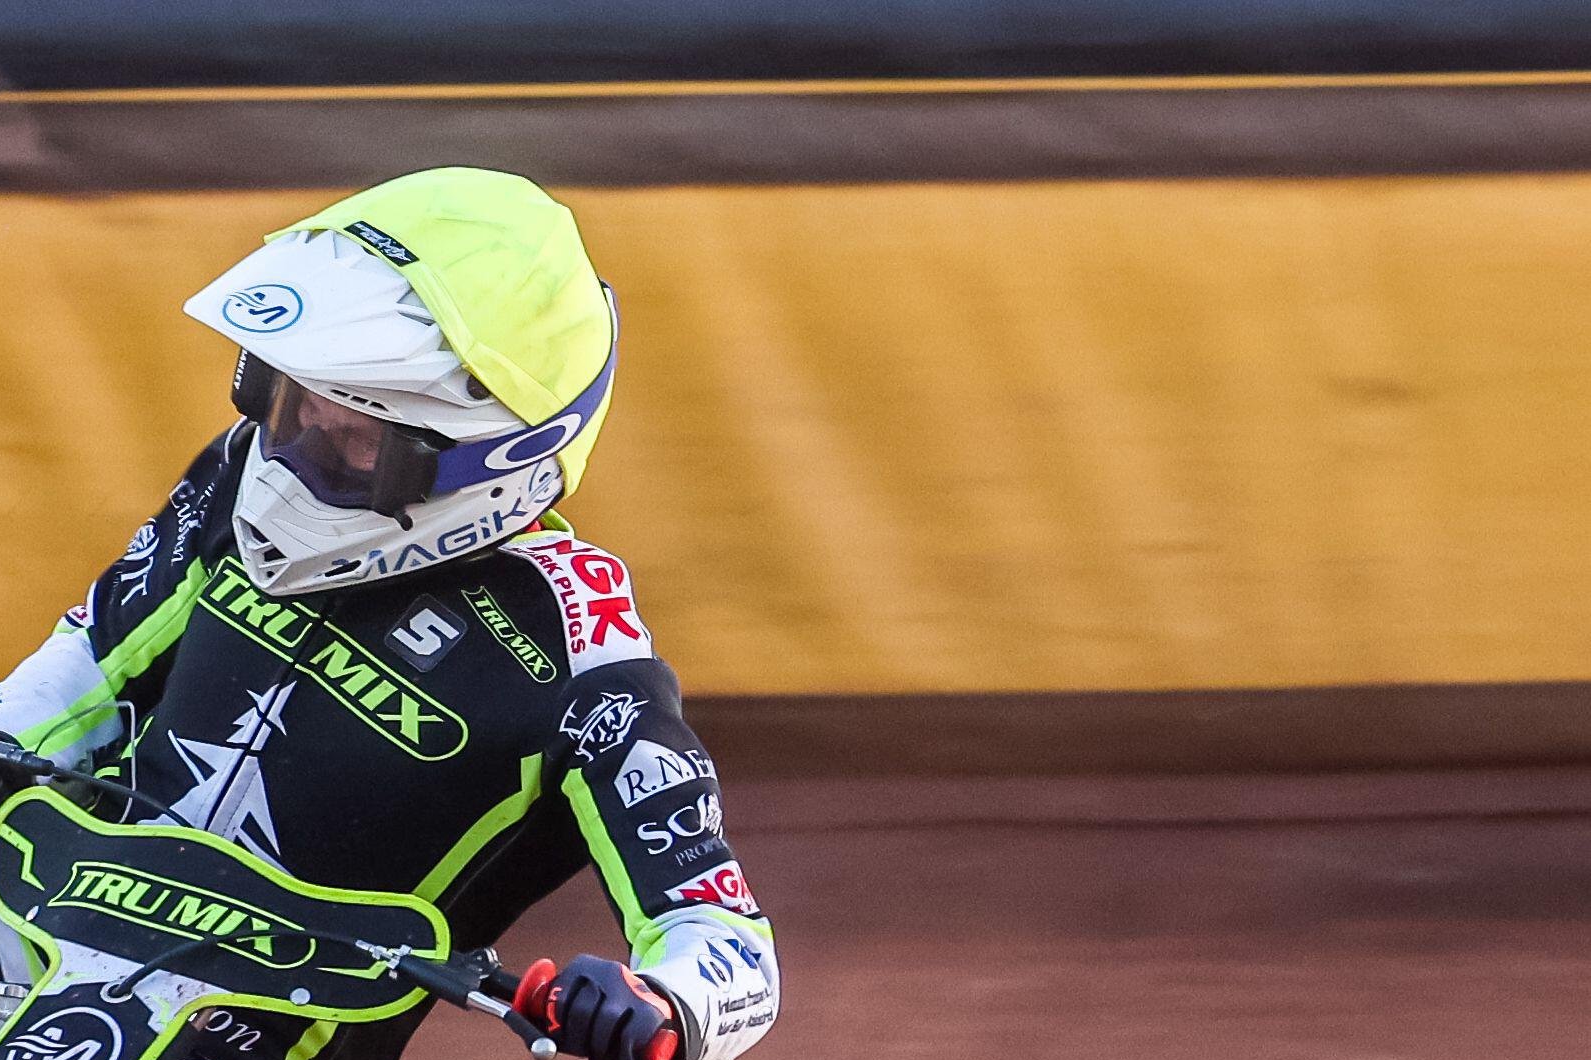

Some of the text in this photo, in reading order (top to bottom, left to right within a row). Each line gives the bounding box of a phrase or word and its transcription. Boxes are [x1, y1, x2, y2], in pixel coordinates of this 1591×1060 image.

[527, 539, 642, 647] NGK
[554, 576, 586, 655] PLUGS
[309, 640, 444, 744] MIX
[508, 634, 550, 675] MIX
[70, 869, 275, 957] TRU MIX
